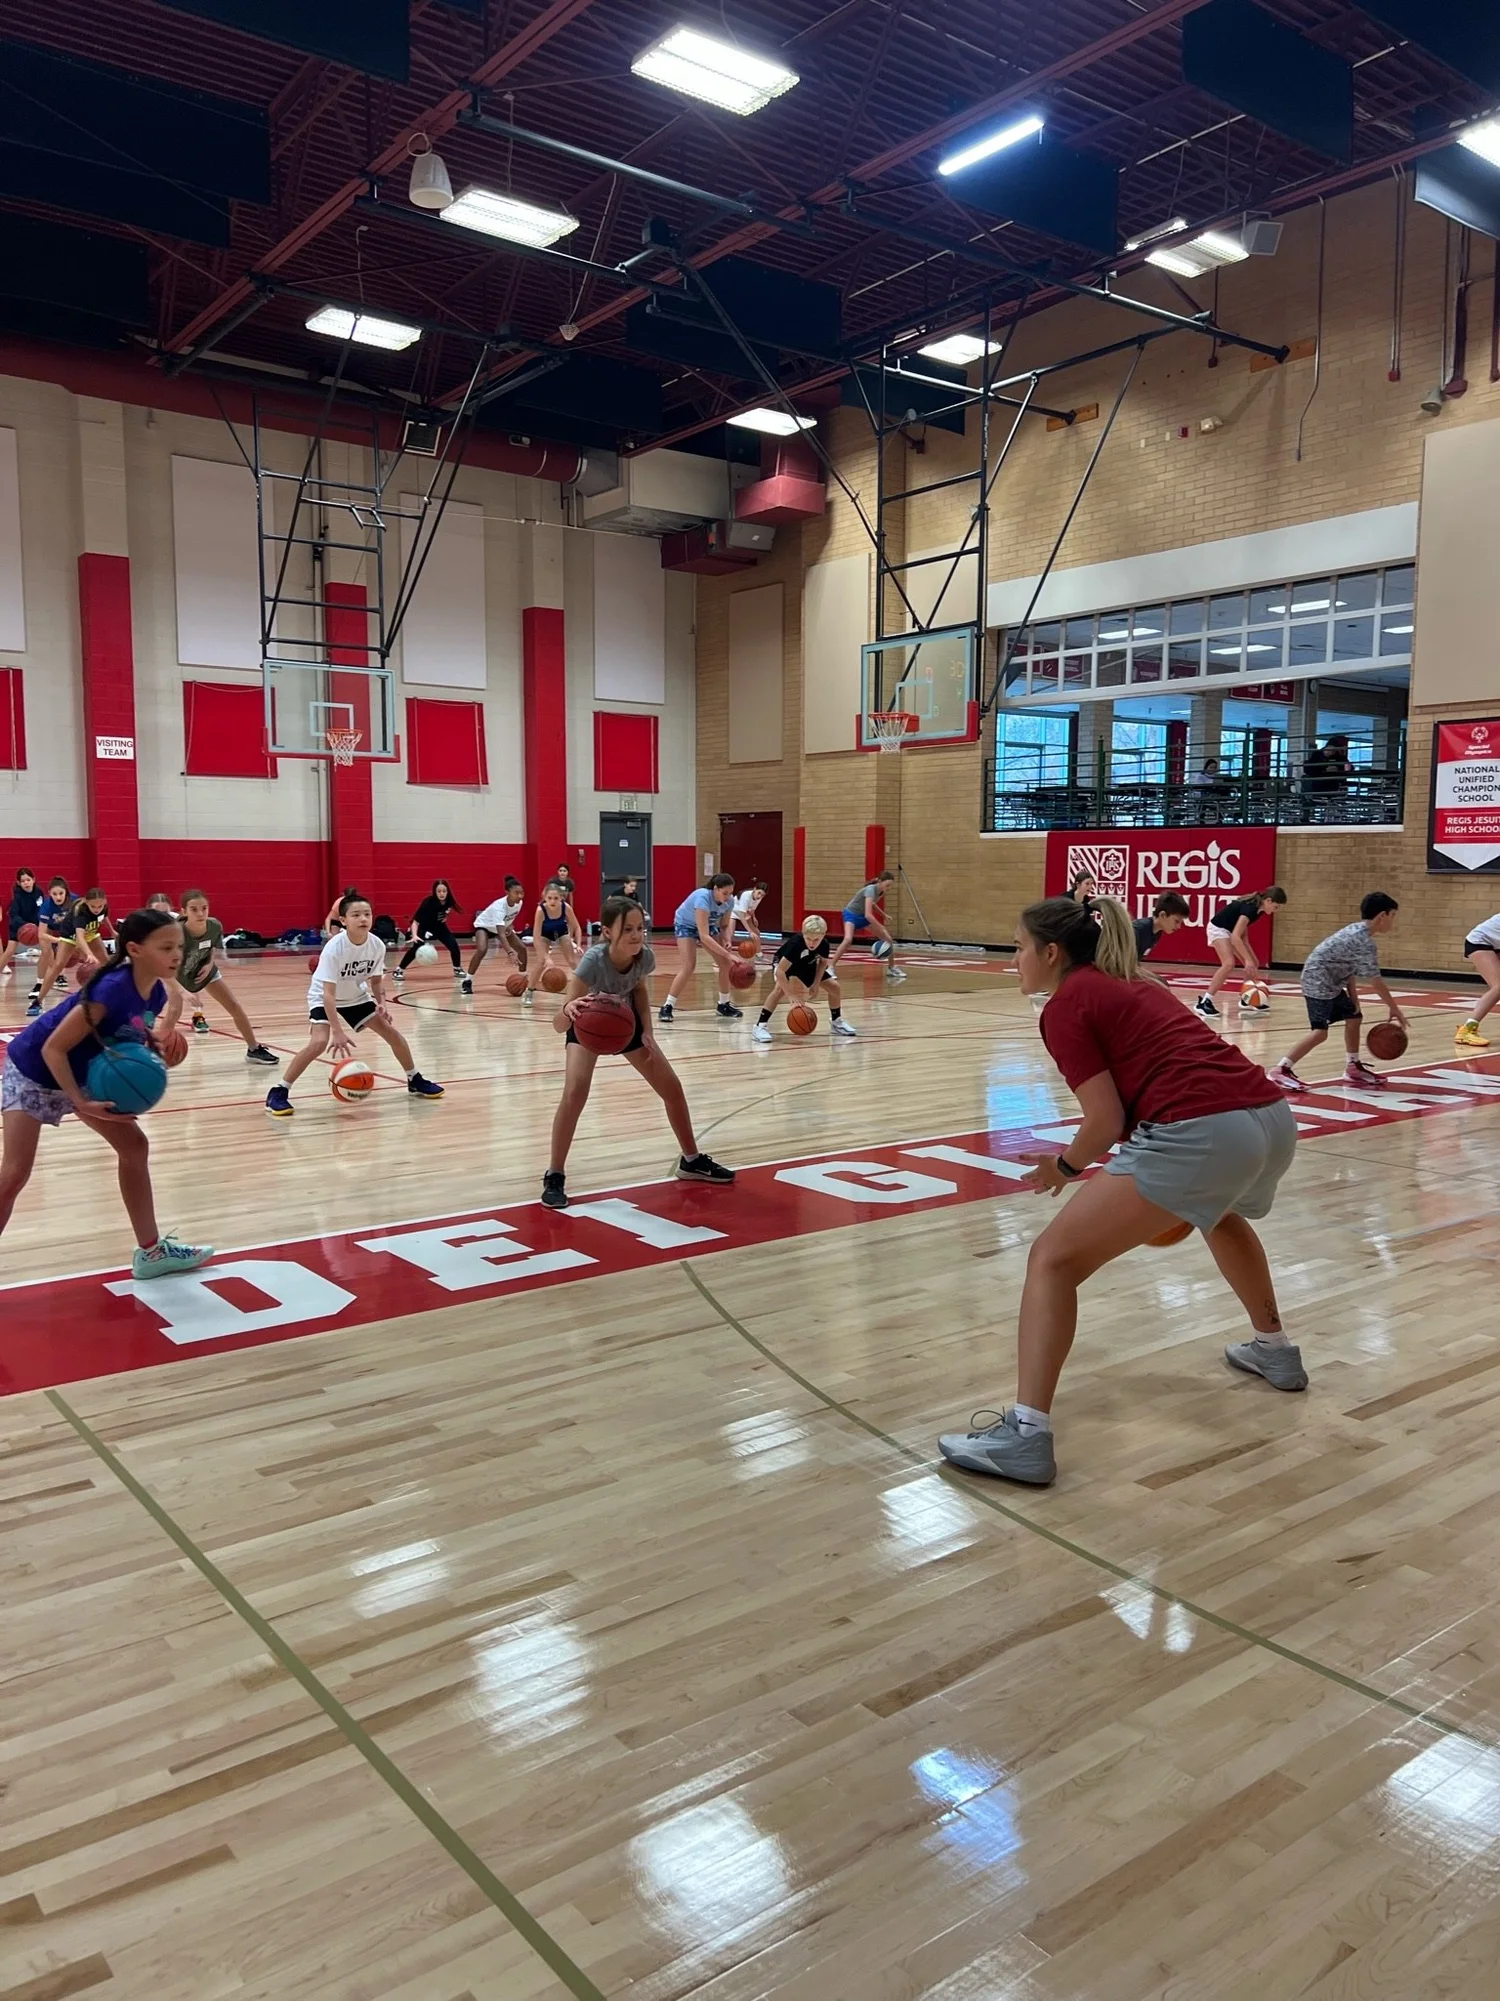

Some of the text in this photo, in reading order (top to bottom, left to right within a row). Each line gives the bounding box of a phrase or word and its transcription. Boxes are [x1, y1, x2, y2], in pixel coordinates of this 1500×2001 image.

[97, 739, 133, 748] VISITING
[103, 748, 127, 756] TEAM
[1454, 765, 1500, 774] NATIONAL
[1458, 775, 1494, 784] UNIFIED
[1452, 784, 1500, 793] CHAMPION
[1457, 794, 1495, 803] SCHOOL
[1446, 816, 1472, 825] REGIS
[1444, 825, 1500, 834] HIGH SCHOO
[102, 1197, 730, 1345] DEI
